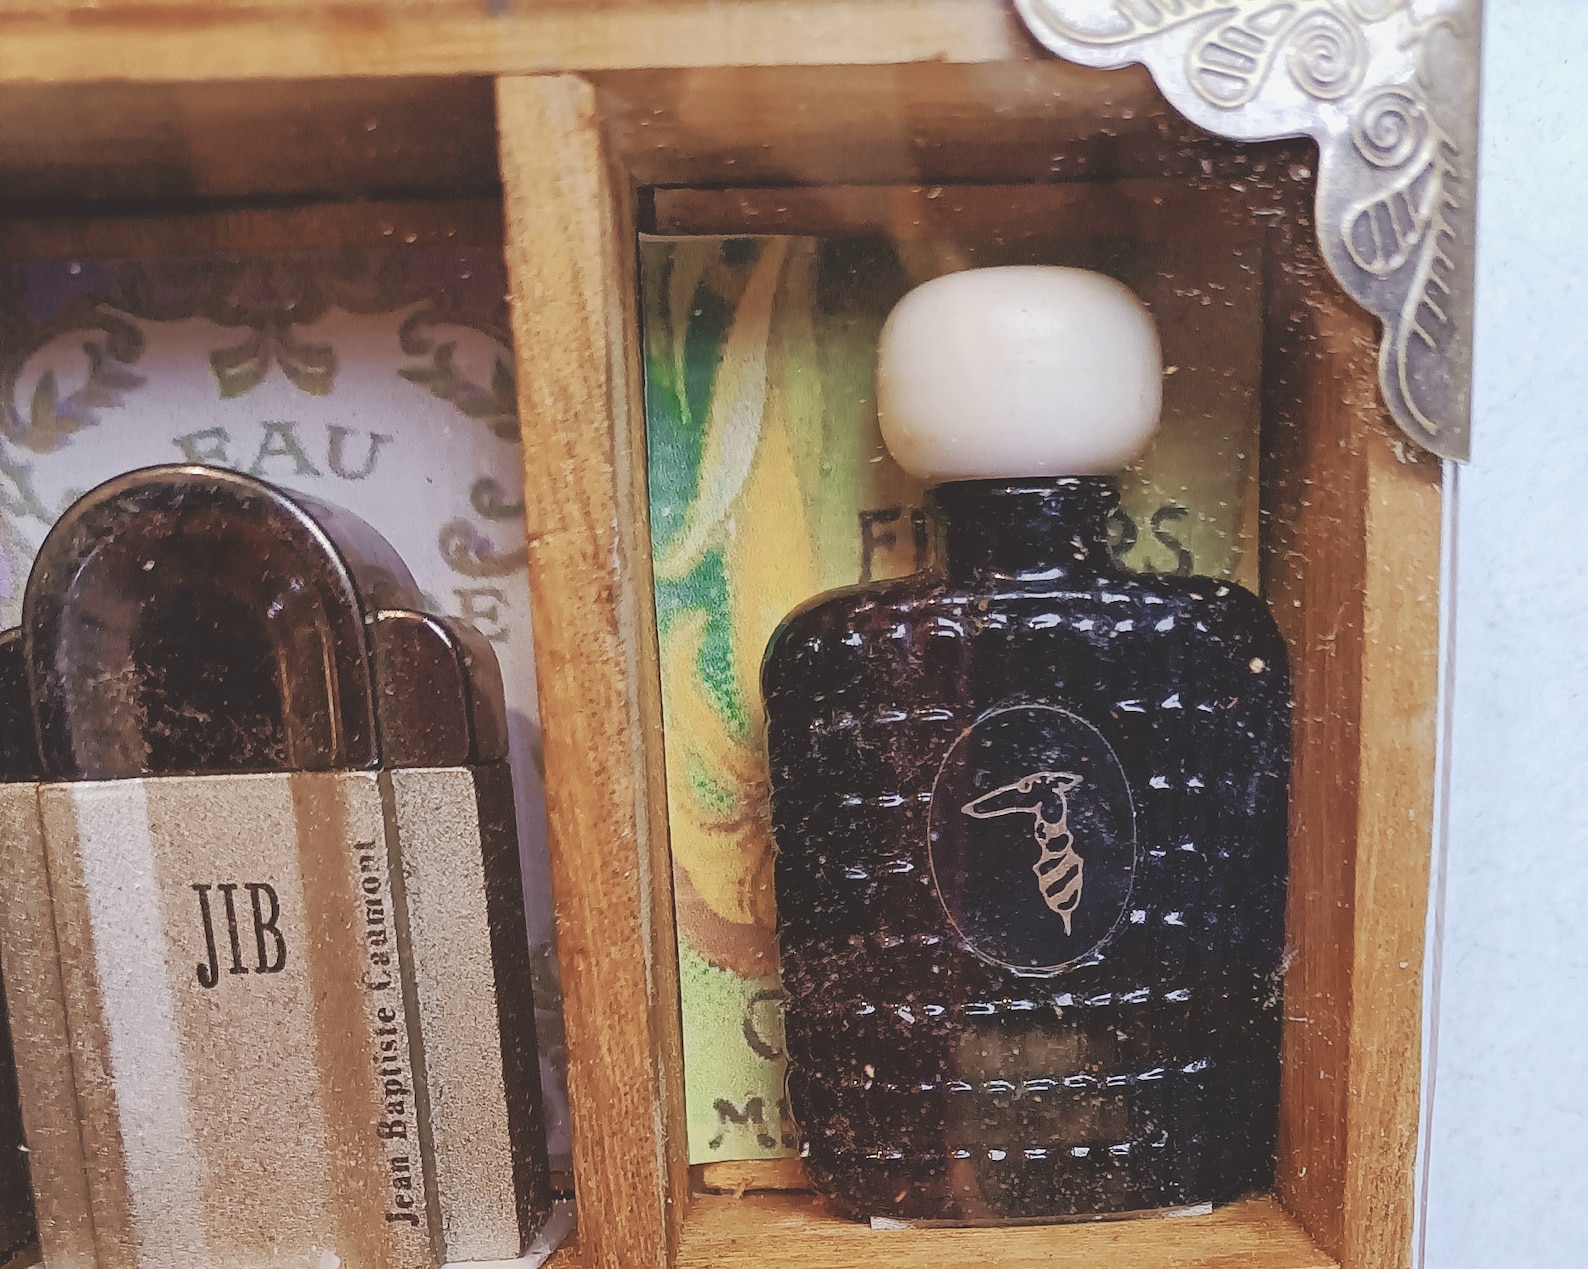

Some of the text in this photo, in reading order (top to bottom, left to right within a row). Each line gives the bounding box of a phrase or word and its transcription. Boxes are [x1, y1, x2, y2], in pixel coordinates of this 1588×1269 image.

[171, 420, 394, 482] EAU
[190, 883, 287, 989] JIB
[372, 1007, 411, 1140] Baptiste
[384, 1156, 420, 1227] Jean
